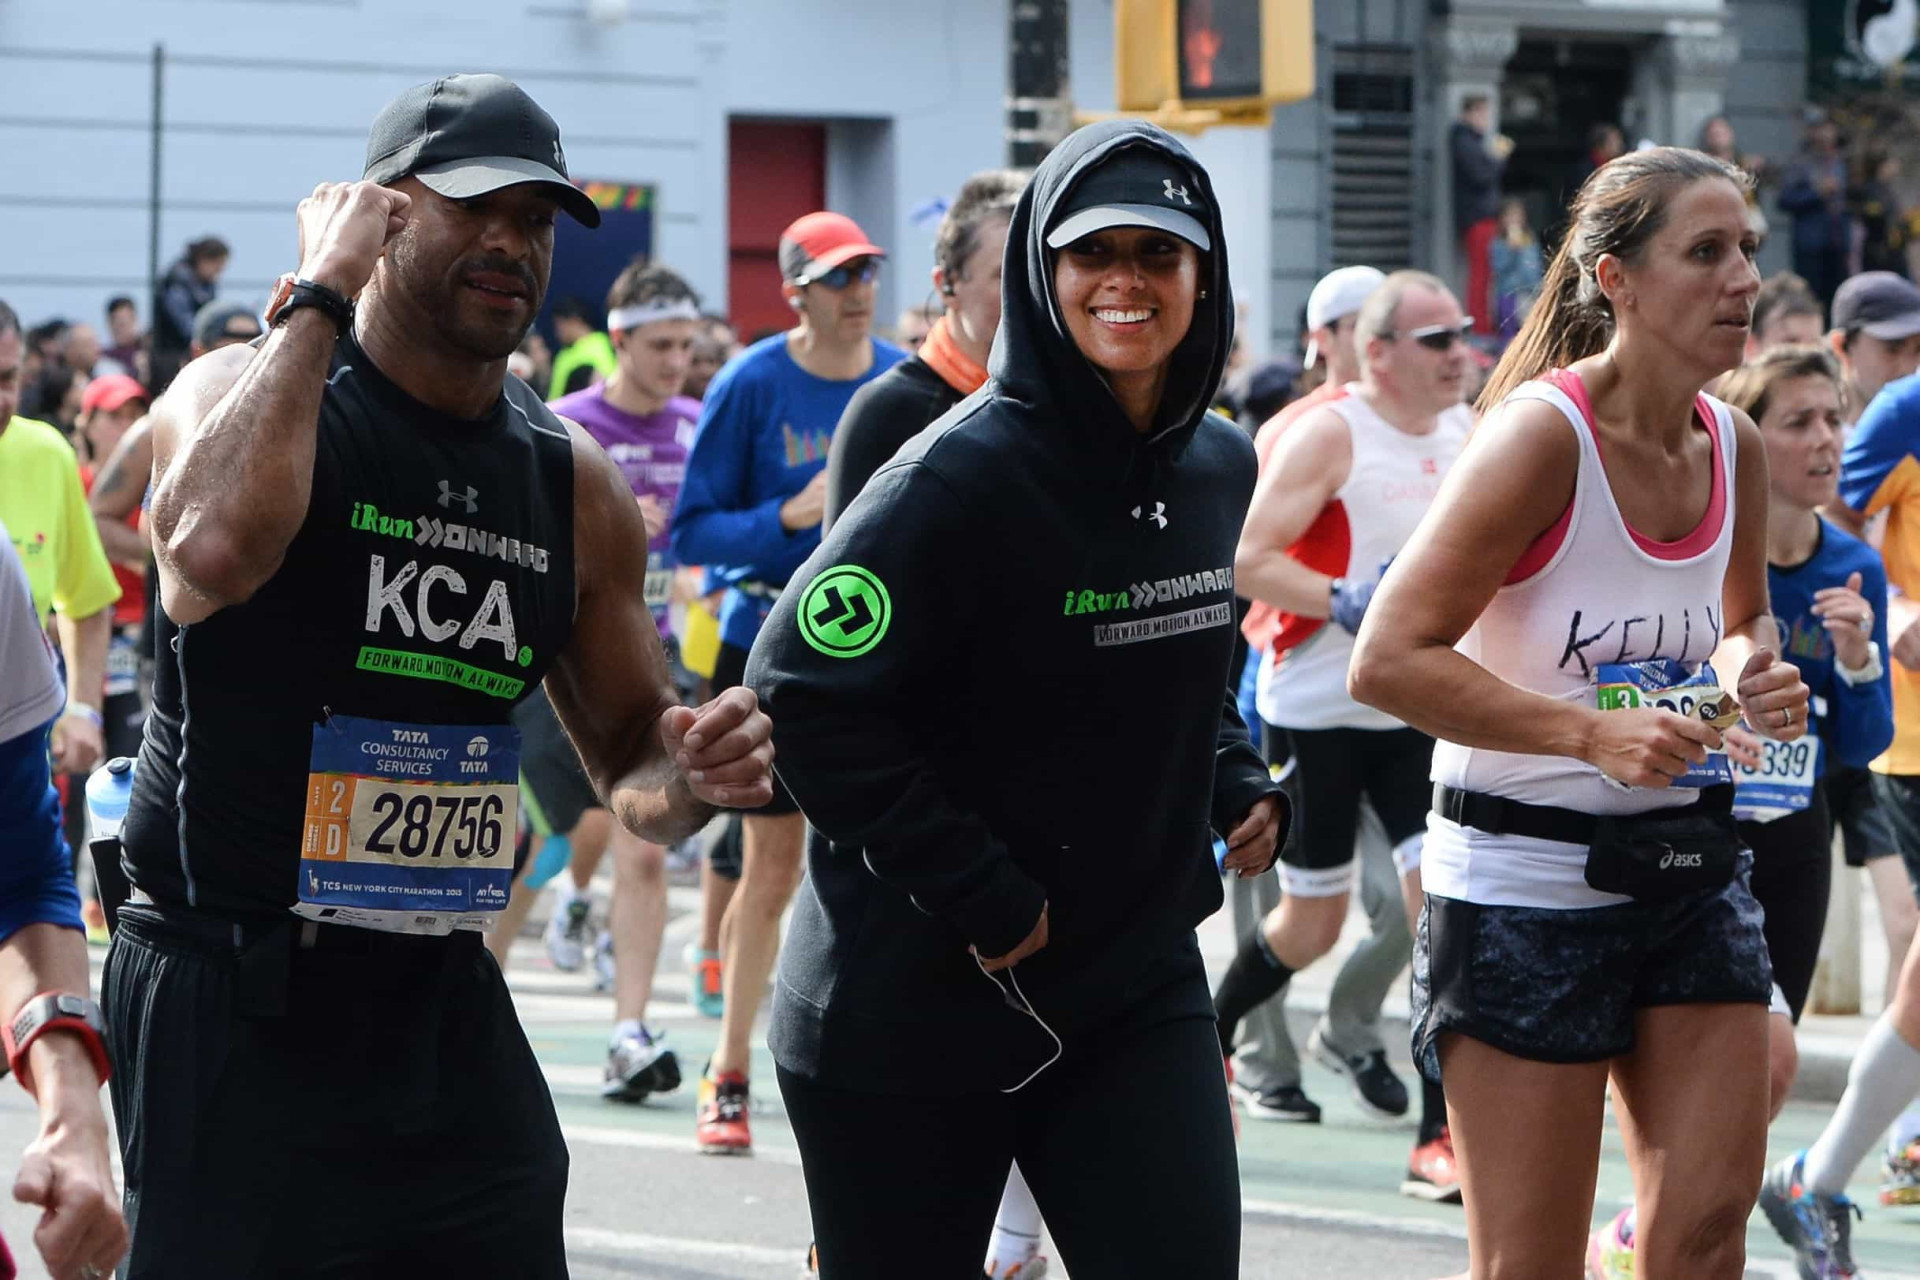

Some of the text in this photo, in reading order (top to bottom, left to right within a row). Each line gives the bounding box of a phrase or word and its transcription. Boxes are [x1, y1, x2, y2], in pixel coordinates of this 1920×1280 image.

[351, 502, 414, 540] iRun
[1064, 589, 1130, 616] iRun
[1558, 600, 1721, 678] KELLY
[391, 729, 429, 744] TATA
[360, 741, 450, 761] CONSULTANCY
[375, 759, 433, 775] SERVICES
[460, 761, 488, 773] TATA
[330, 780, 346, 813] 2
[364, 792, 504, 858] 28756
[326, 823, 341, 855] D
[1674, 853, 1702, 867] asics
[323, 881, 341, 891] TCS
[343, 884, 362, 892] NEW
[364, 884, 387, 893] YORK
[388, 886, 403, 894] CITY
[404, 887, 443, 896] MARATHON
